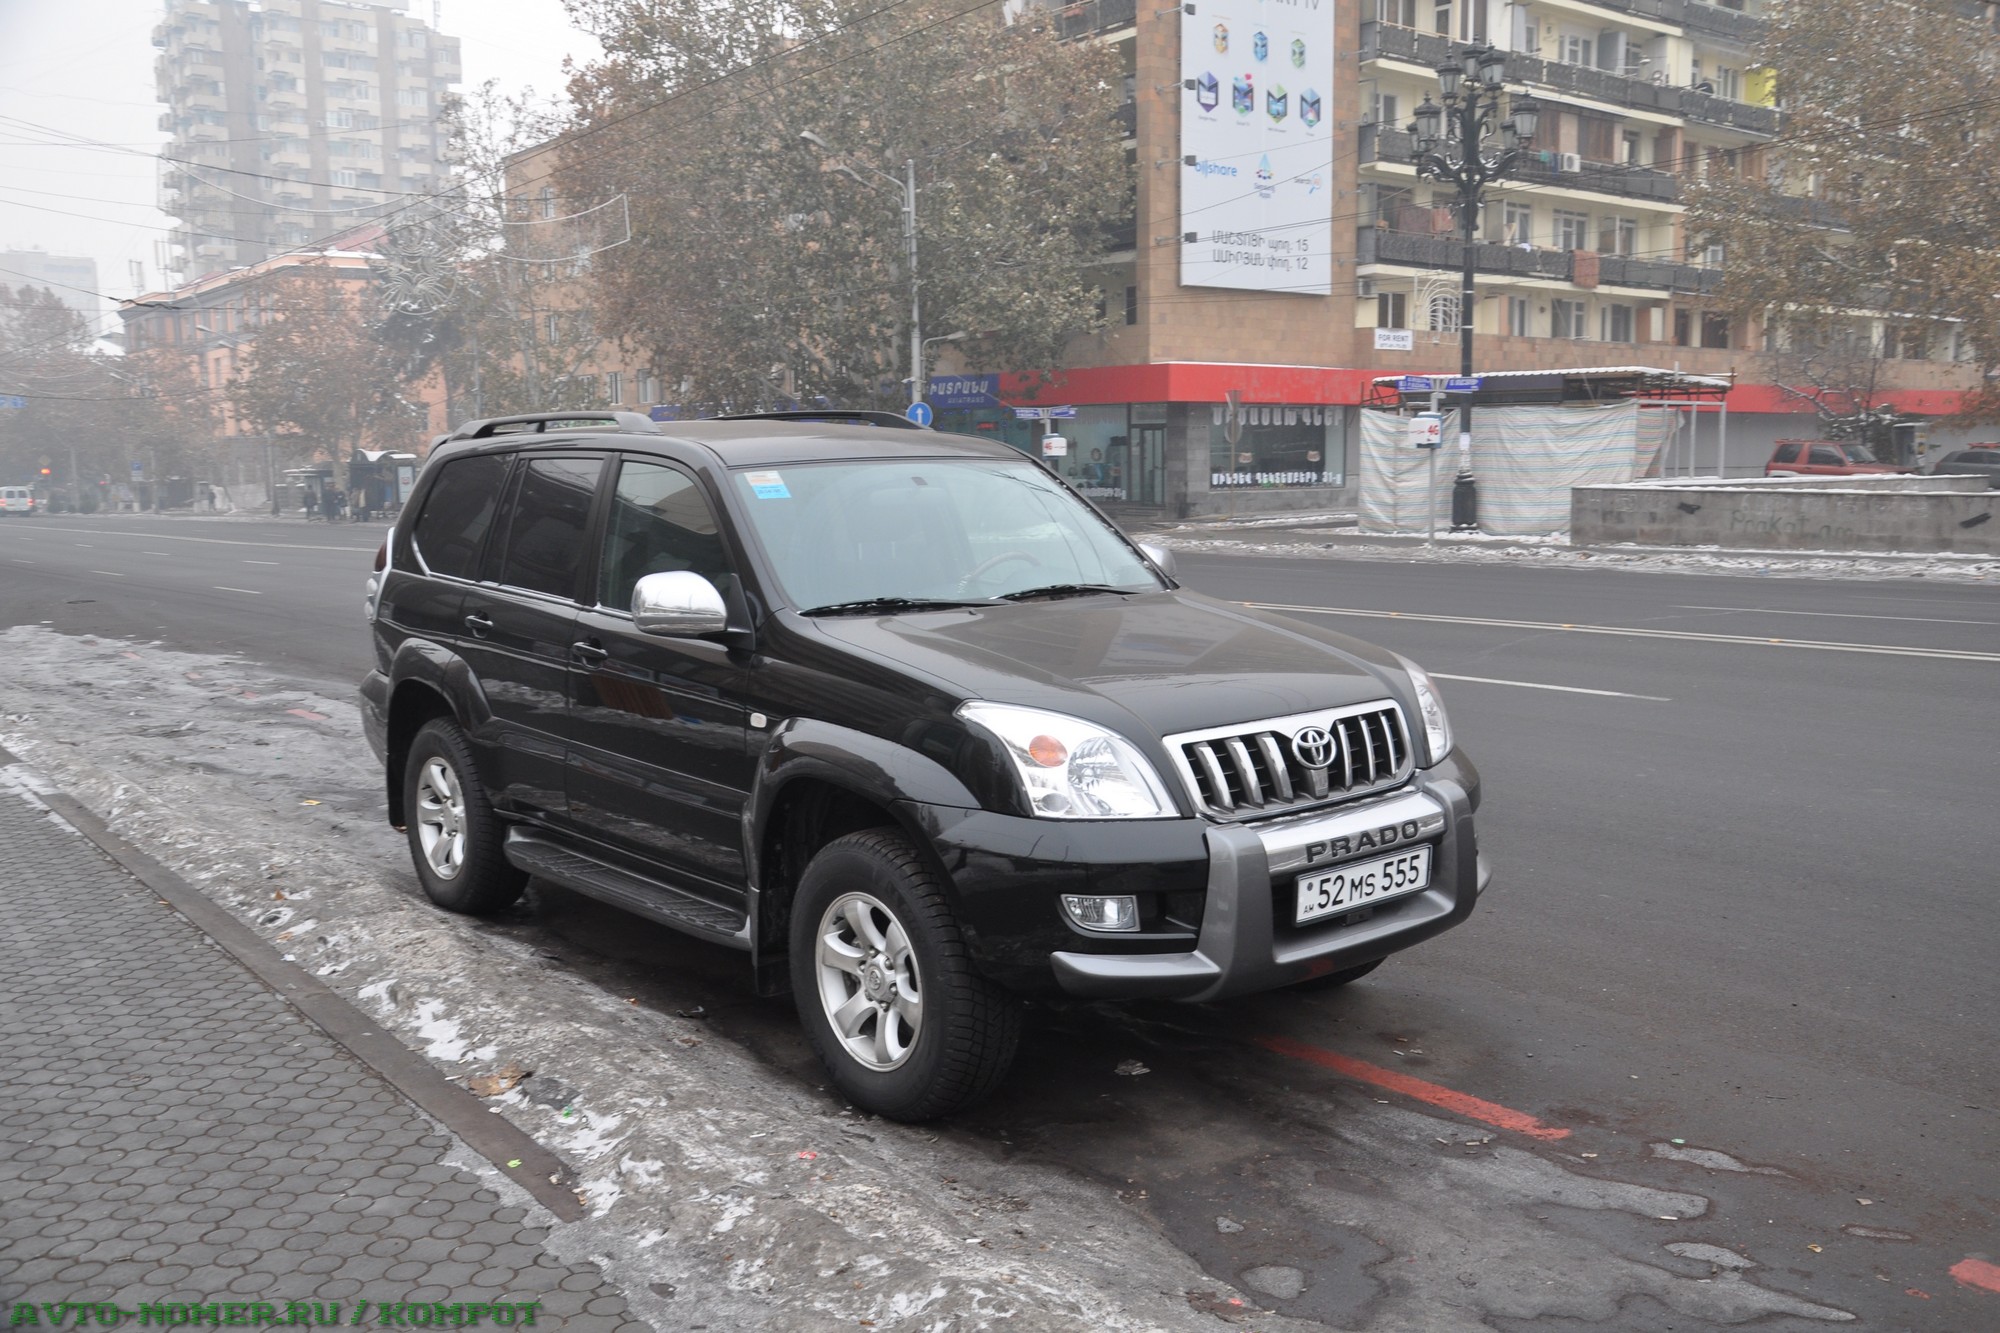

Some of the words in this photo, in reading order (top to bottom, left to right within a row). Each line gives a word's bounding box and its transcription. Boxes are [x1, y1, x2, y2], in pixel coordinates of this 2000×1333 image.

[1296, 239, 1309, 252] 15
[1296, 257, 1308, 270] 12
[1306, 820, 1418, 863] PRADO
[1317, 874, 1345, 909] 52
[1350, 872, 1375, 902] MS
[1381, 854, 1420, 892] 555
